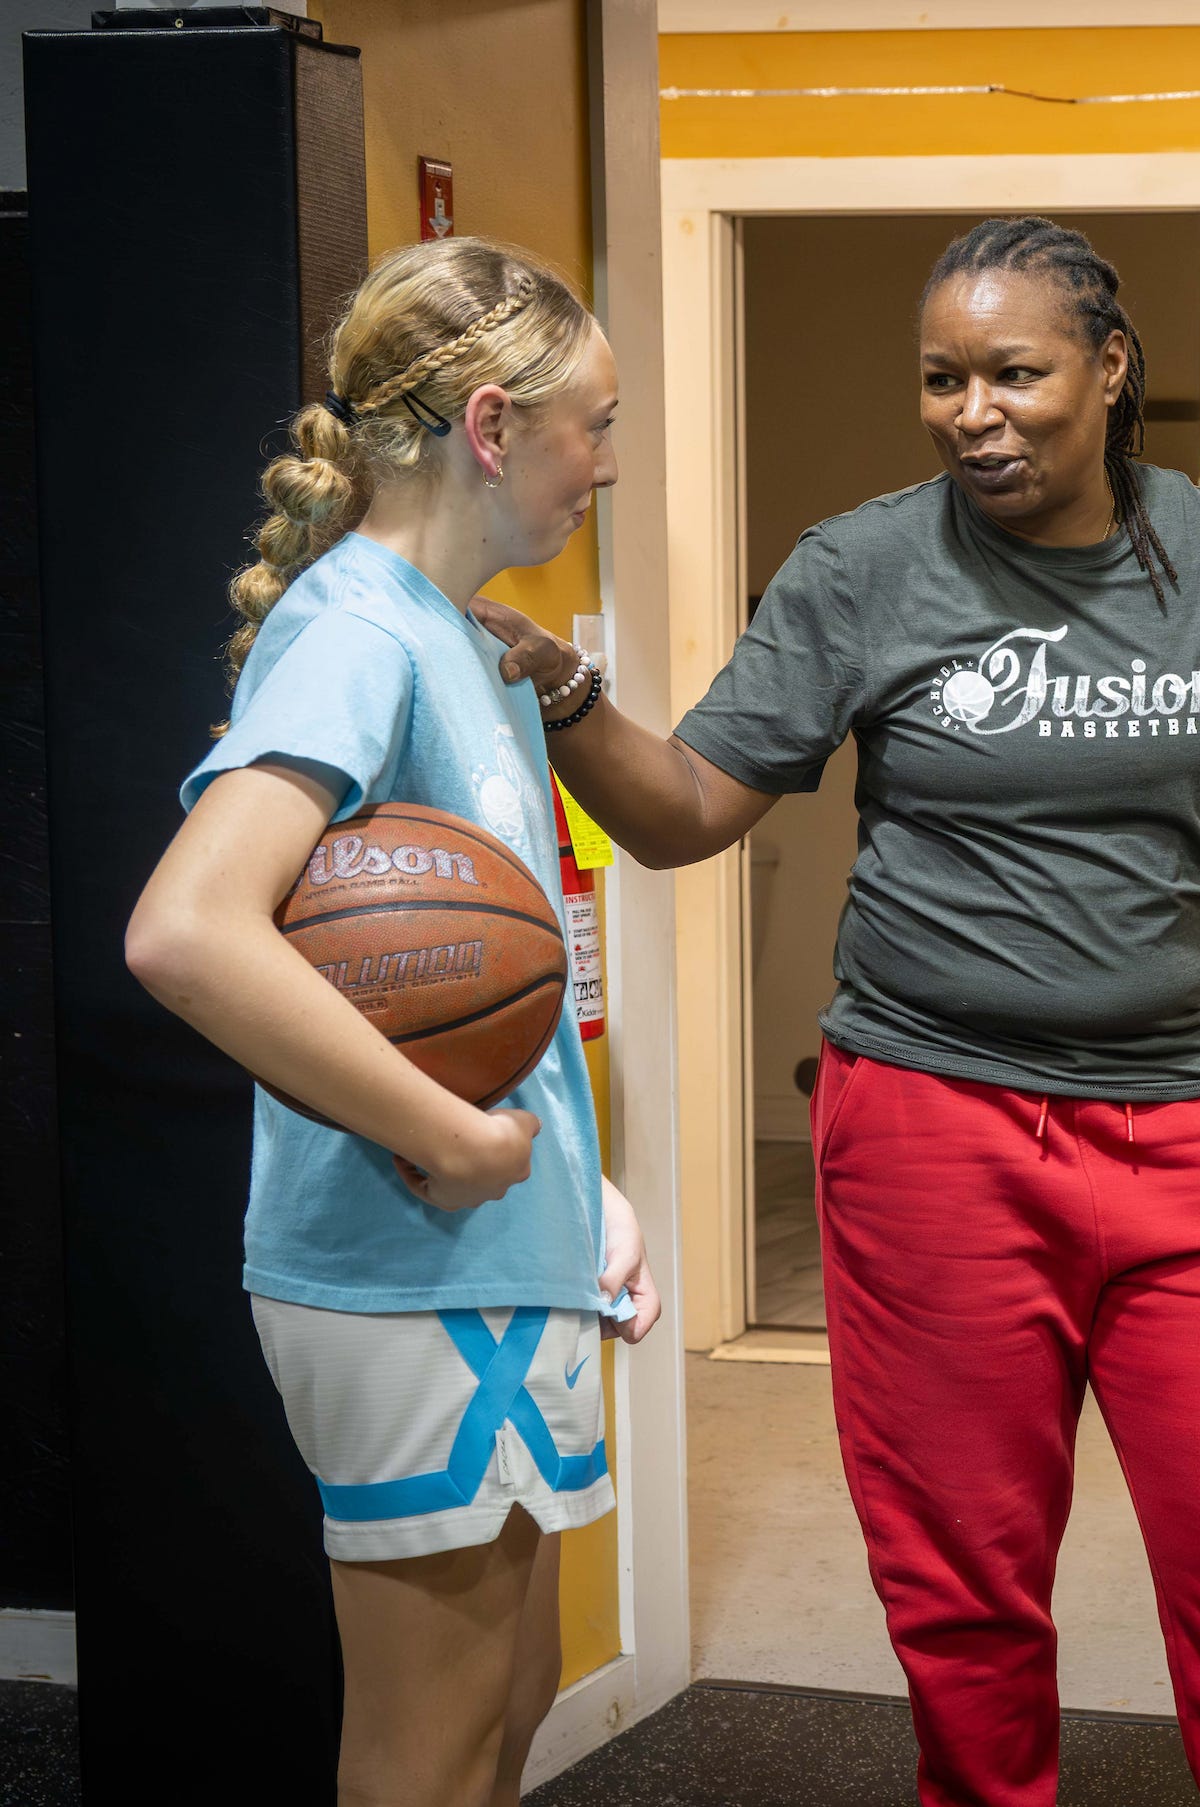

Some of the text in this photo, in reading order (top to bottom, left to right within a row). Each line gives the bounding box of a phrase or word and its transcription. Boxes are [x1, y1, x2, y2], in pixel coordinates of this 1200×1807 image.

[306, 834, 479, 887] ilson
[314, 940, 484, 989] OLUTION
[345, 983, 405, 998] CROFIBER
